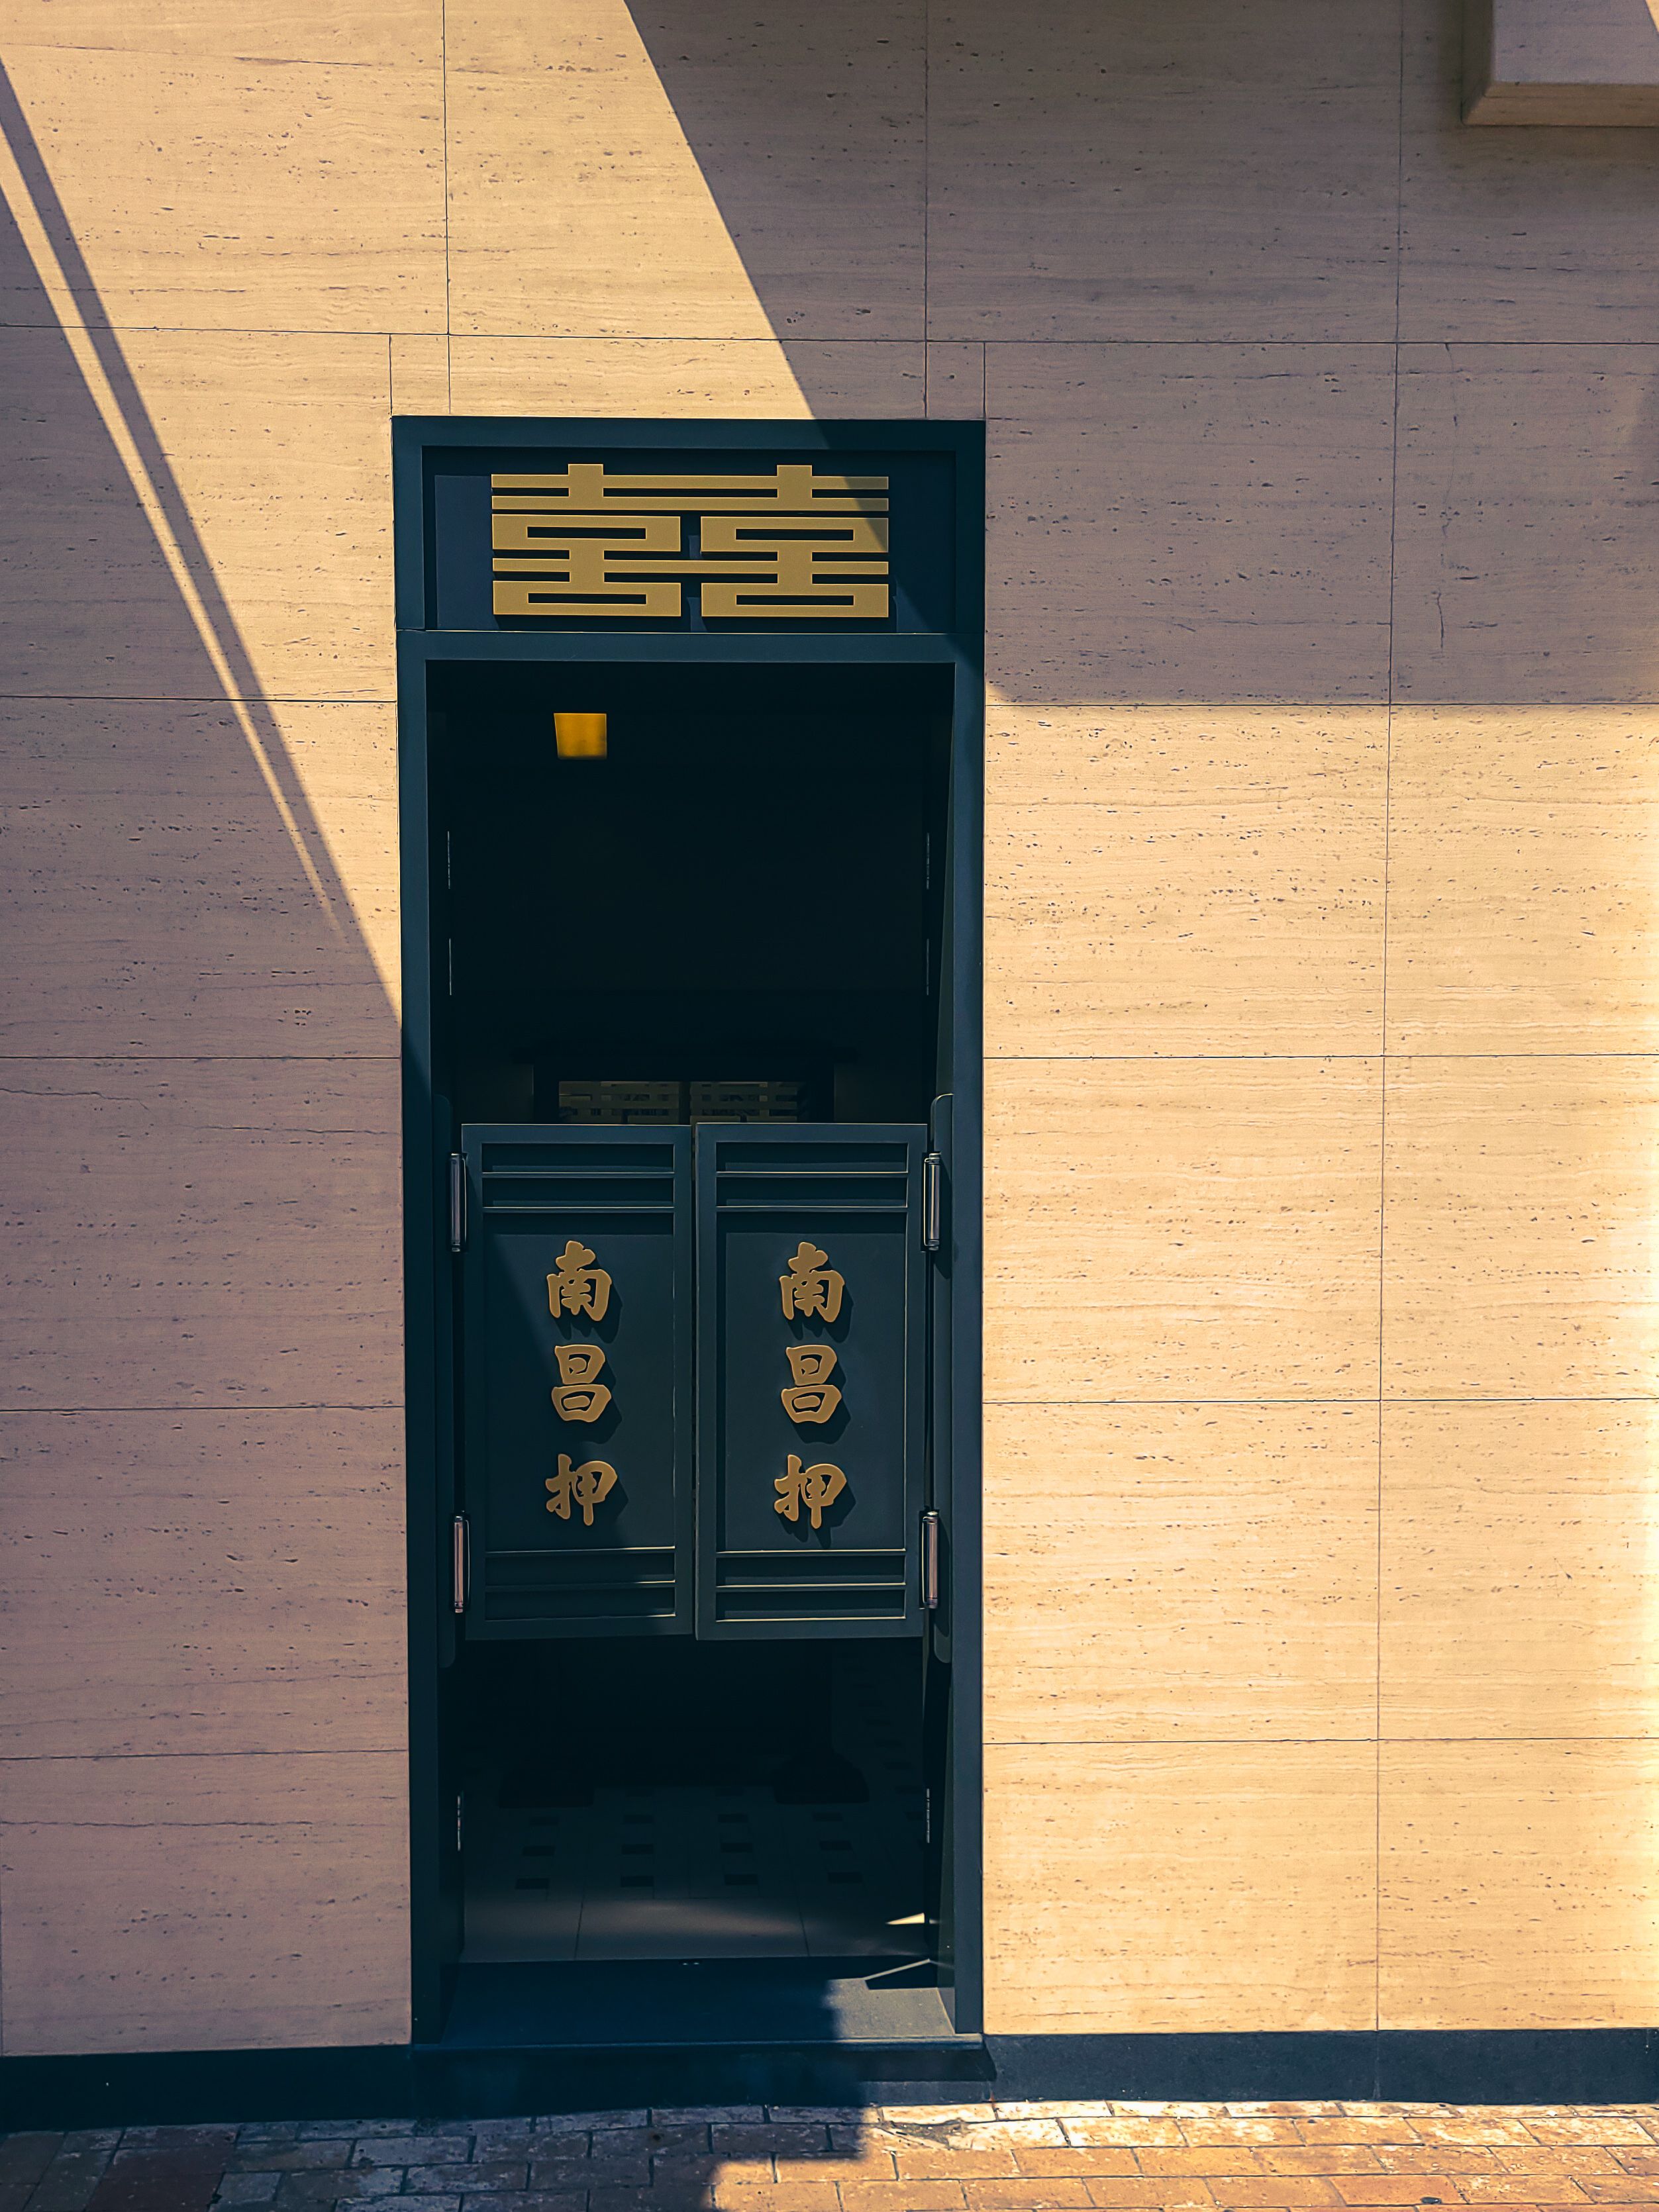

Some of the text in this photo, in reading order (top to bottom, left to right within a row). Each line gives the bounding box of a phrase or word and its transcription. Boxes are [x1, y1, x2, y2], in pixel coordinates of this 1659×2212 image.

[546, 1240, 618, 1526] 南昌押
[774, 1241, 847, 1529] 南昌押
